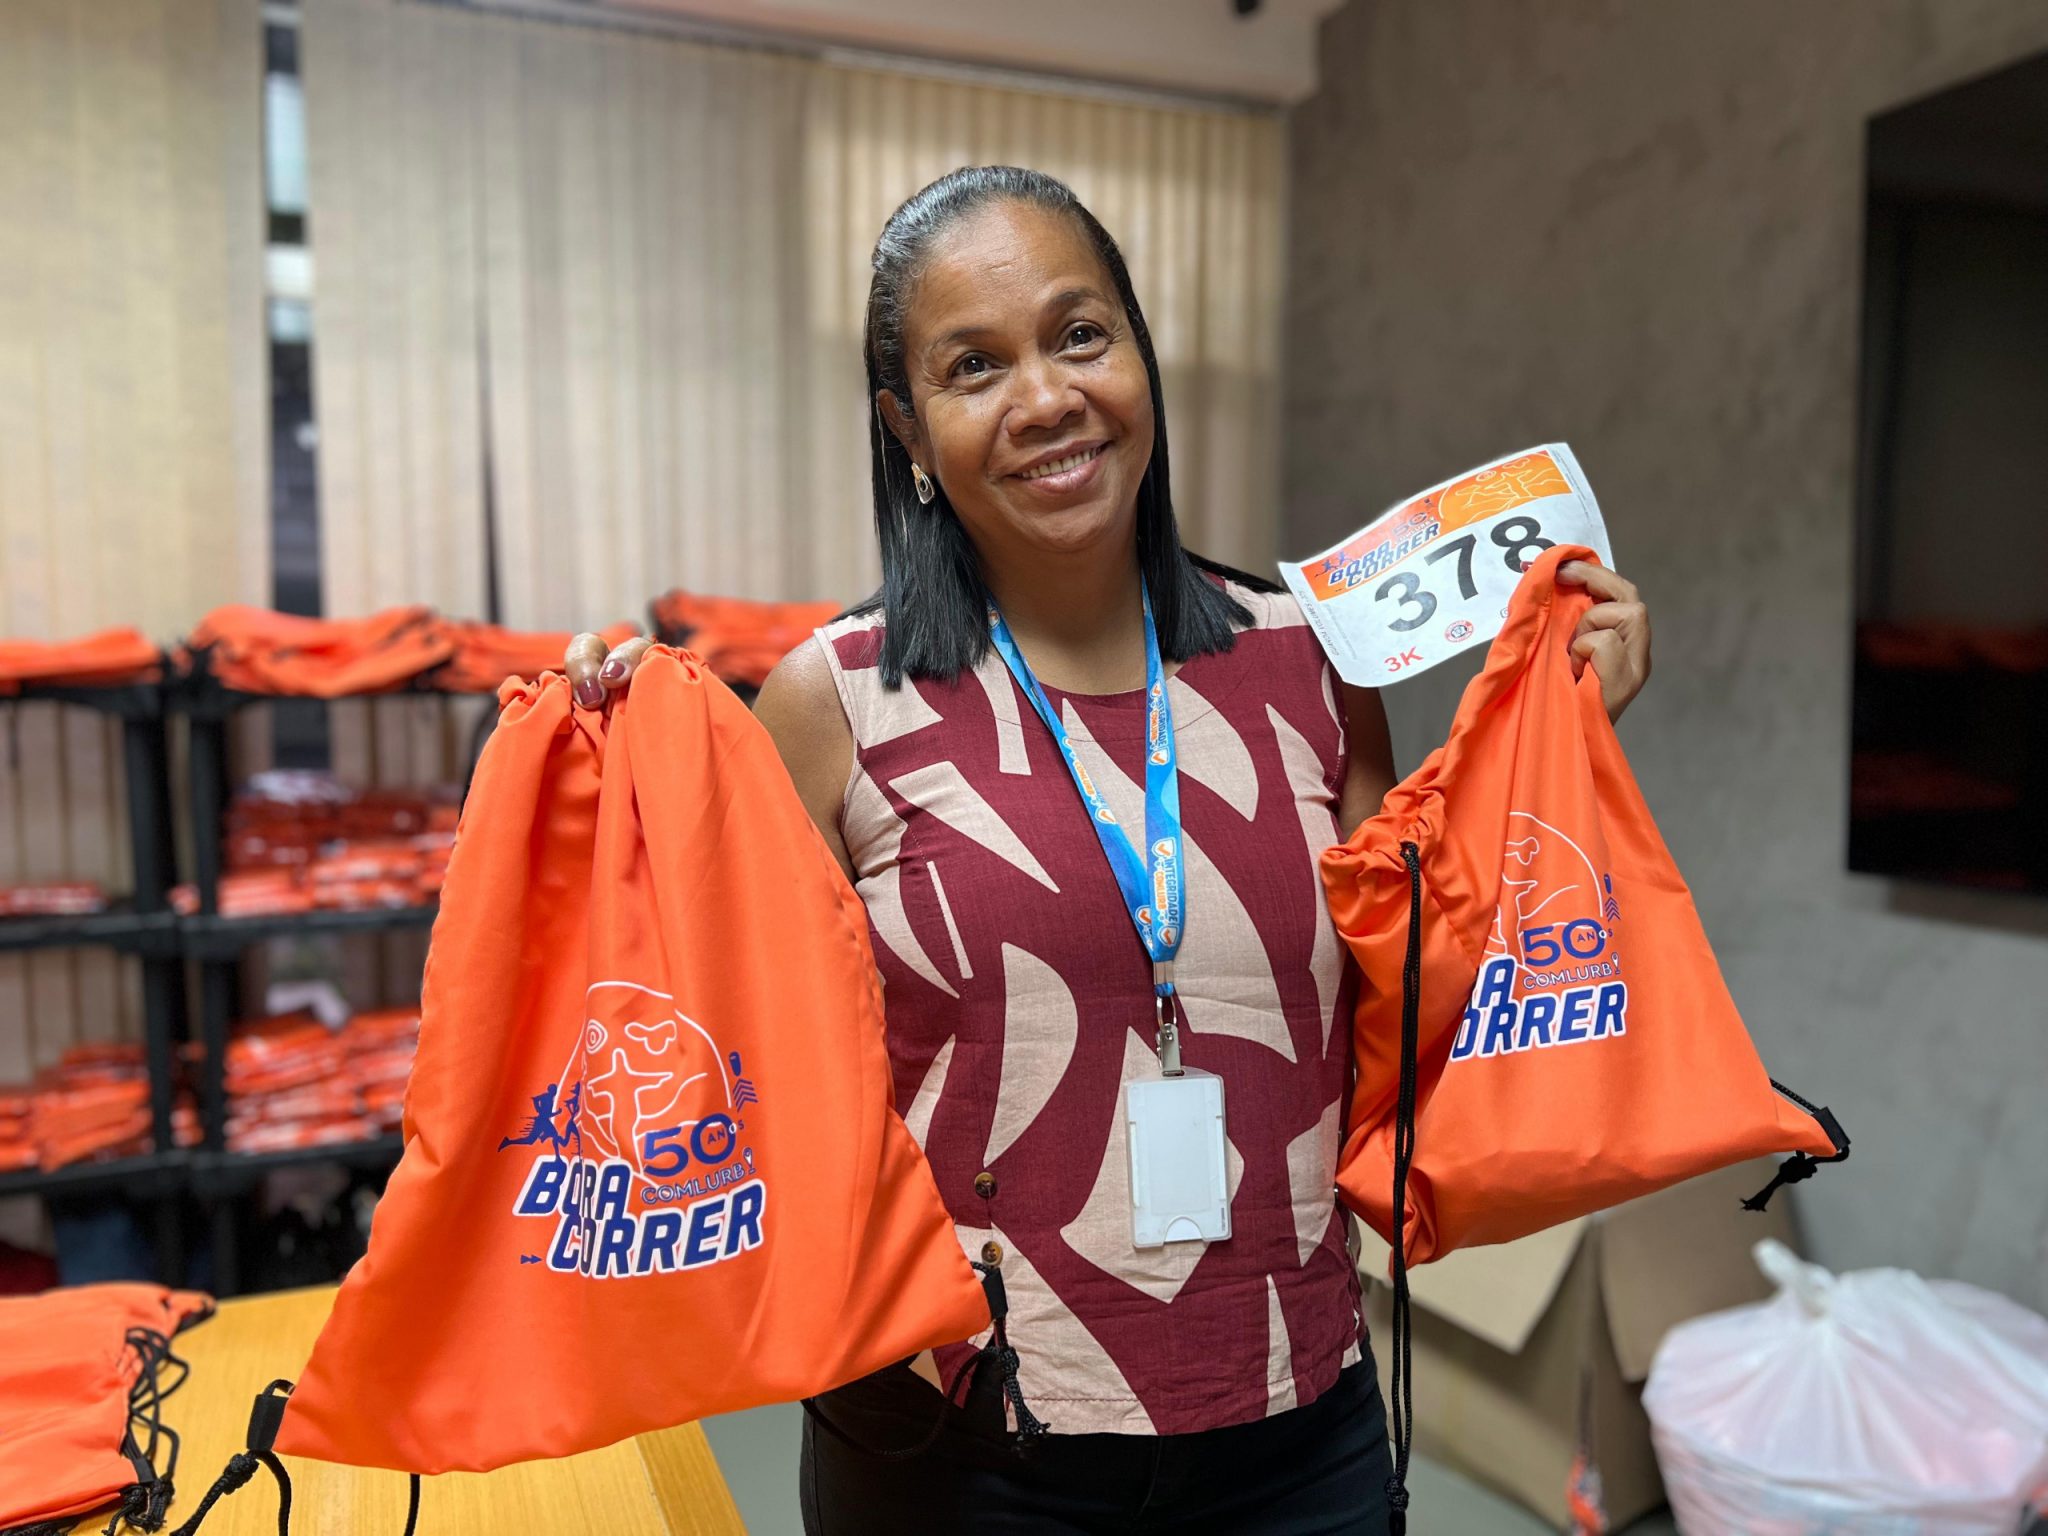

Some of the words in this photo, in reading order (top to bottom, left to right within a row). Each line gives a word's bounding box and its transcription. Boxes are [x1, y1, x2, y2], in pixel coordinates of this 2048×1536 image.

[1328, 539, 1391, 586] BORA
[1346, 522, 1441, 589] CORRER
[1374, 516, 1557, 632] 378
[1384, 647, 1424, 673] 3K
[1154, 870, 1168, 911] COMLURB
[1165, 858, 1178, 925] INTEGRIDADE
[1523, 918, 1606, 967] 50
[1523, 961, 1612, 990] COMLURB
[1450, 981, 1628, 1062] ORRER
[643, 1112, 737, 1177] 50
[513, 1155, 634, 1222] BORA
[641, 1163, 747, 1205] COMLURB
[546, 1179, 767, 1279] CORRER
